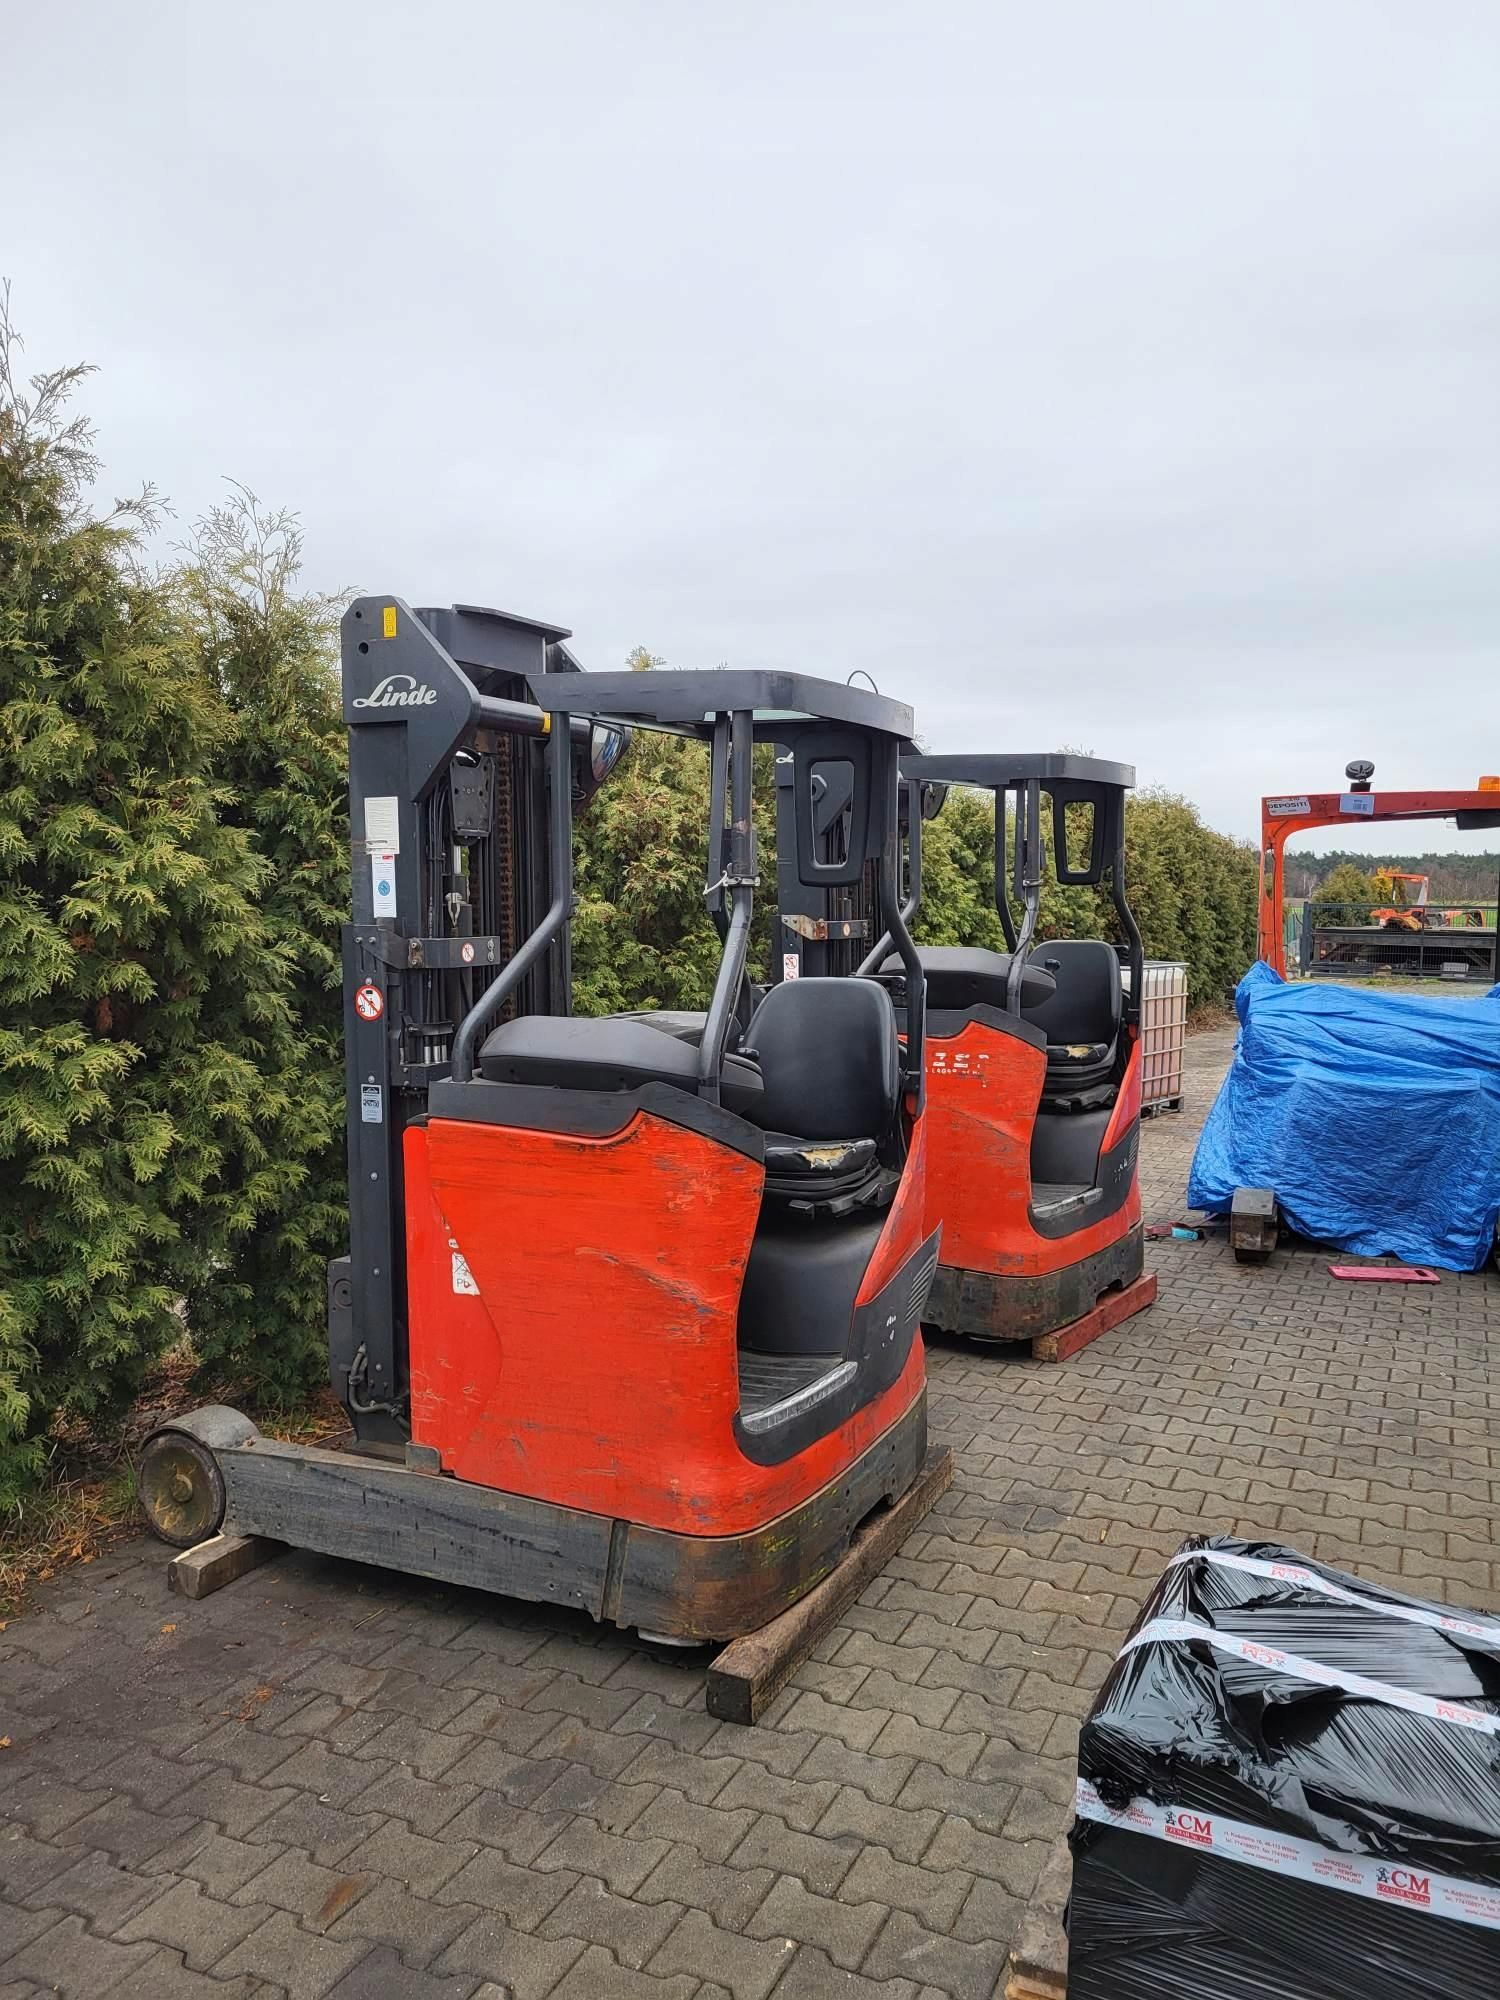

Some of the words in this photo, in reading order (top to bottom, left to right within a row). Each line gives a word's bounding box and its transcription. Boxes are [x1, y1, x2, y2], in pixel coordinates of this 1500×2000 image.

[352, 674, 437, 708] Linde
[1177, 1813, 1213, 1837] CM
[1391, 1869, 1431, 1894] CM
